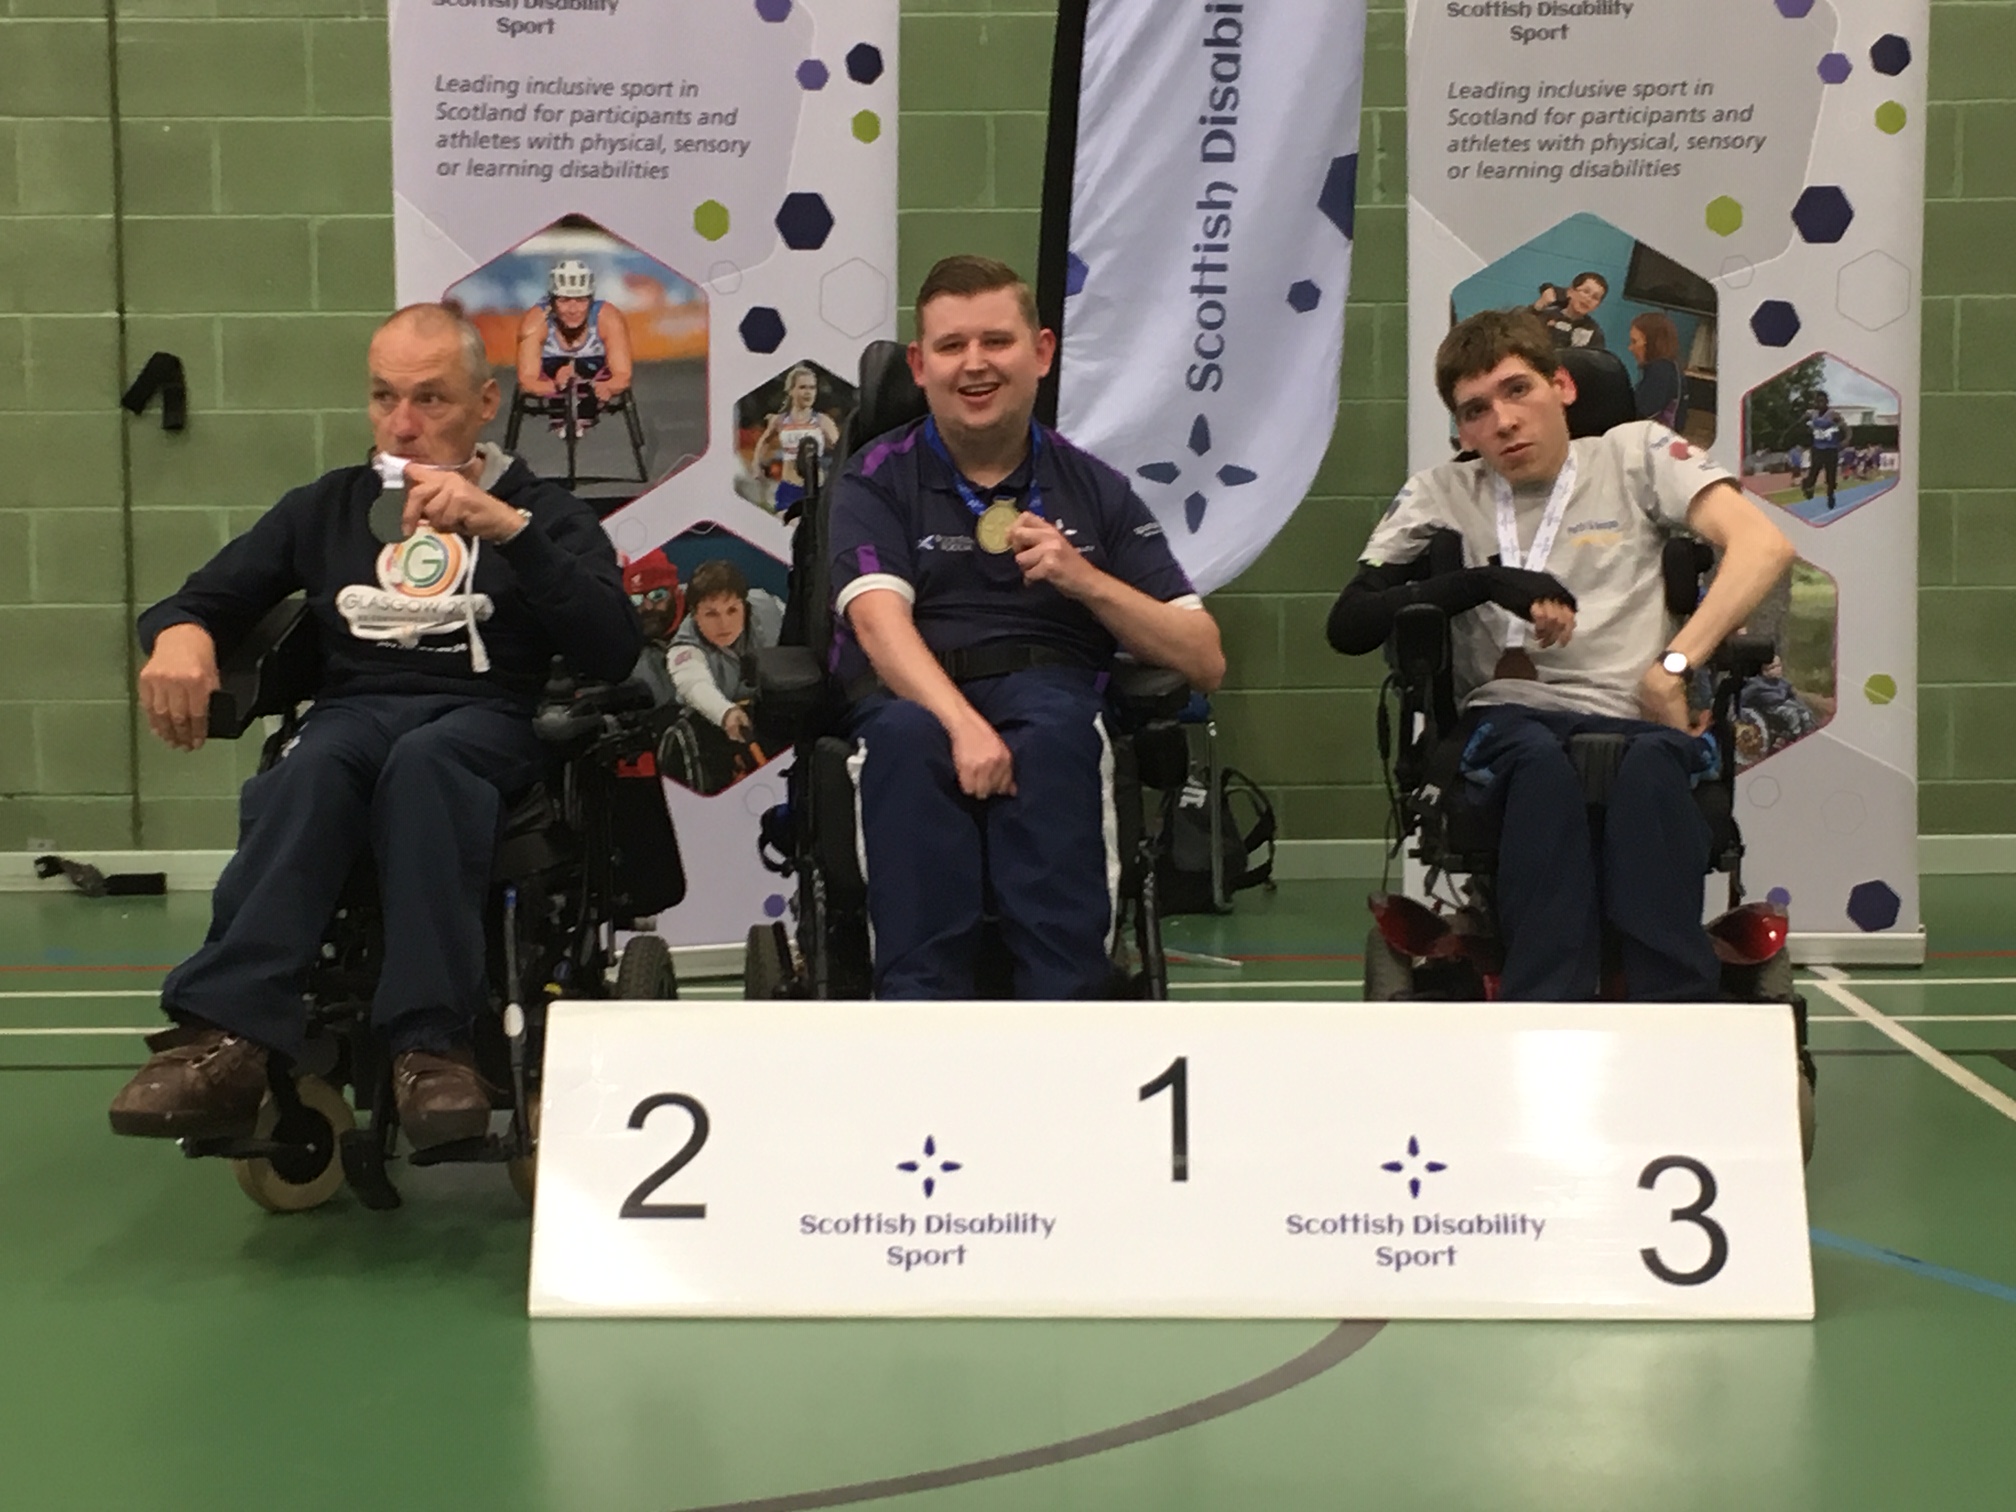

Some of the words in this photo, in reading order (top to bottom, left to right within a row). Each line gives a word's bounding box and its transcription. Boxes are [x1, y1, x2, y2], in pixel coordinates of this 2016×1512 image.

[1447, 1, 1532, 18] Scottish
[1537, 0, 1634, 19] Disability
[496, 17, 556, 38] Sport
[1510, 24, 1570, 45] Sport
[434, 74, 520, 99] Leading
[526, 75, 615, 97] inclusive
[620, 80, 673, 101] sport
[679, 79, 699, 98] in
[1447, 81, 1531, 104] Leading
[1537, 79, 1627, 99] inclusive
[1632, 80, 1688, 101] sport
[1694, 78, 1715, 97] in
[435, 102, 528, 122] Scotland
[533, 103, 565, 122] for
[569, 105, 693, 128] participants
[697, 107, 739, 126] and
[1447, 108, 1539, 127] Scotland
[1544, 106, 1576, 125] for
[1580, 105, 1706, 128] participants
[1712, 104, 1754, 123] and
[435, 130, 521, 150] athletes
[527, 132, 574, 151] with
[580, 133, 667, 156] physical,
[673, 138, 751, 158] sensory
[1447, 133, 1531, 153] athletes
[1537, 133, 1585, 152] with
[1590, 132, 1679, 156] physical,
[1687, 134, 1767, 154] sensory
[436, 161, 461, 177] or
[466, 157, 553, 183] learning
[559, 159, 670, 180] disabilities
[1447, 164, 1471, 180] or
[1476, 160, 1564, 184] learning
[1569, 159, 1682, 178] disabilities
[1185, 180, 1238, 392] Scottish
[342, 593, 441, 613] GLASGOW
[1138, 1056, 1190, 1182] 1
[619, 1092, 711, 1220] 2
[800, 1213, 916, 1237] Scottish
[925, 1212, 1056, 1239] Disability
[1286, 1213, 1404, 1238] Scottish
[1412, 1212, 1546, 1241] Disability
[1637, 1155, 1730, 1287] 3
[887, 1244, 967, 1272] Sport
[1375, 1245, 1458, 1273] Sport
